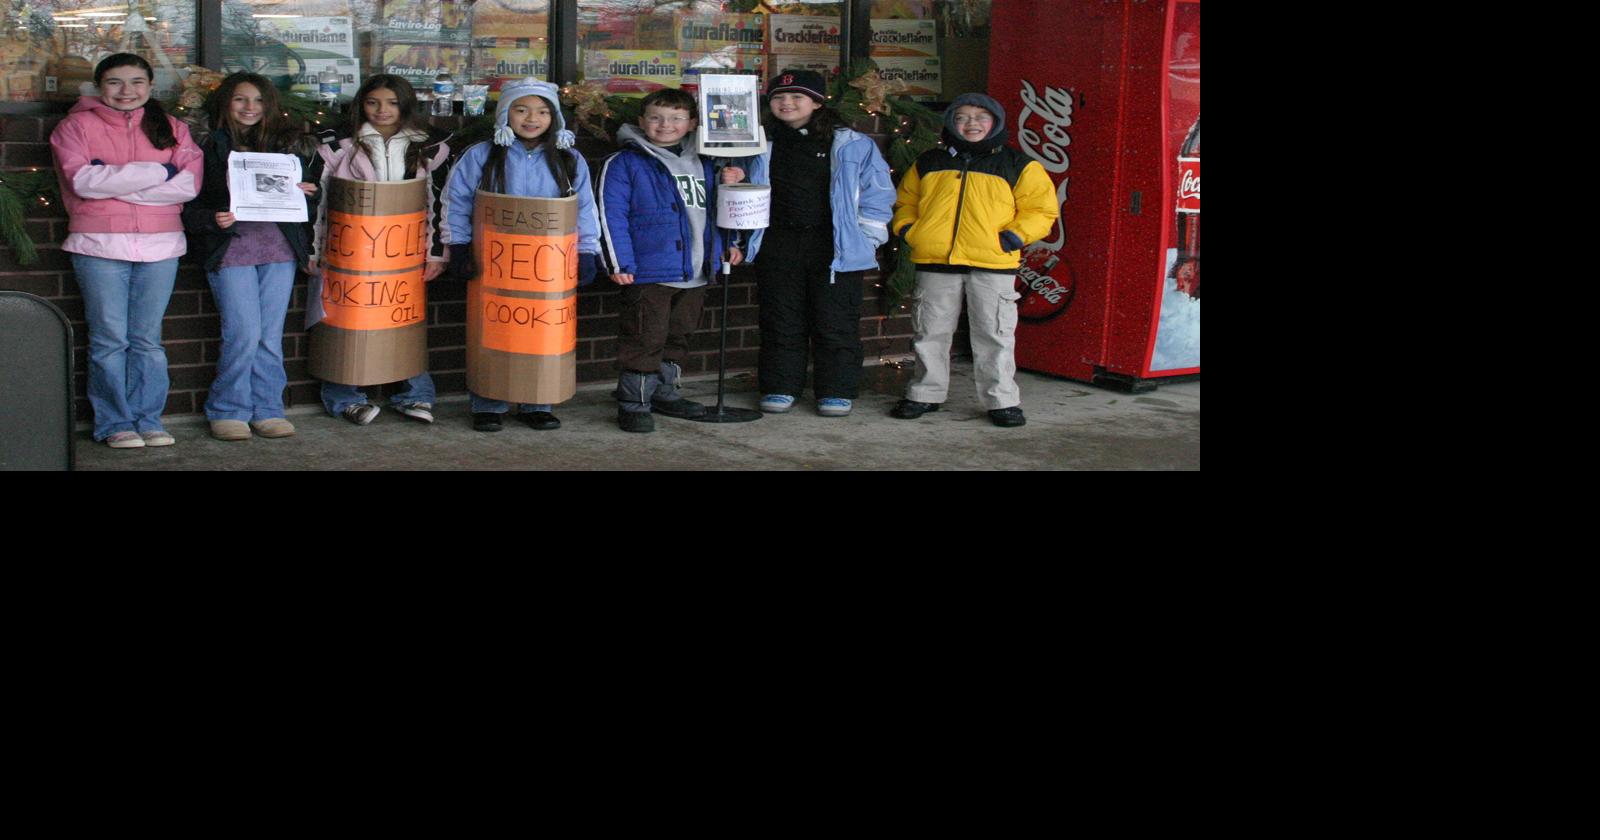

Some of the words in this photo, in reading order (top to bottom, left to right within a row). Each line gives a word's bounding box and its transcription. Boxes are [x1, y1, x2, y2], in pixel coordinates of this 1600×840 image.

[282, 29, 346, 43] duraflame
[683, 22, 763, 42] duraflame
[873, 32, 933, 43] Crackleflame
[609, 60, 676, 75] duraflame
[483, 206, 559, 230] PLEASE
[391, 304, 419, 323] OIL
